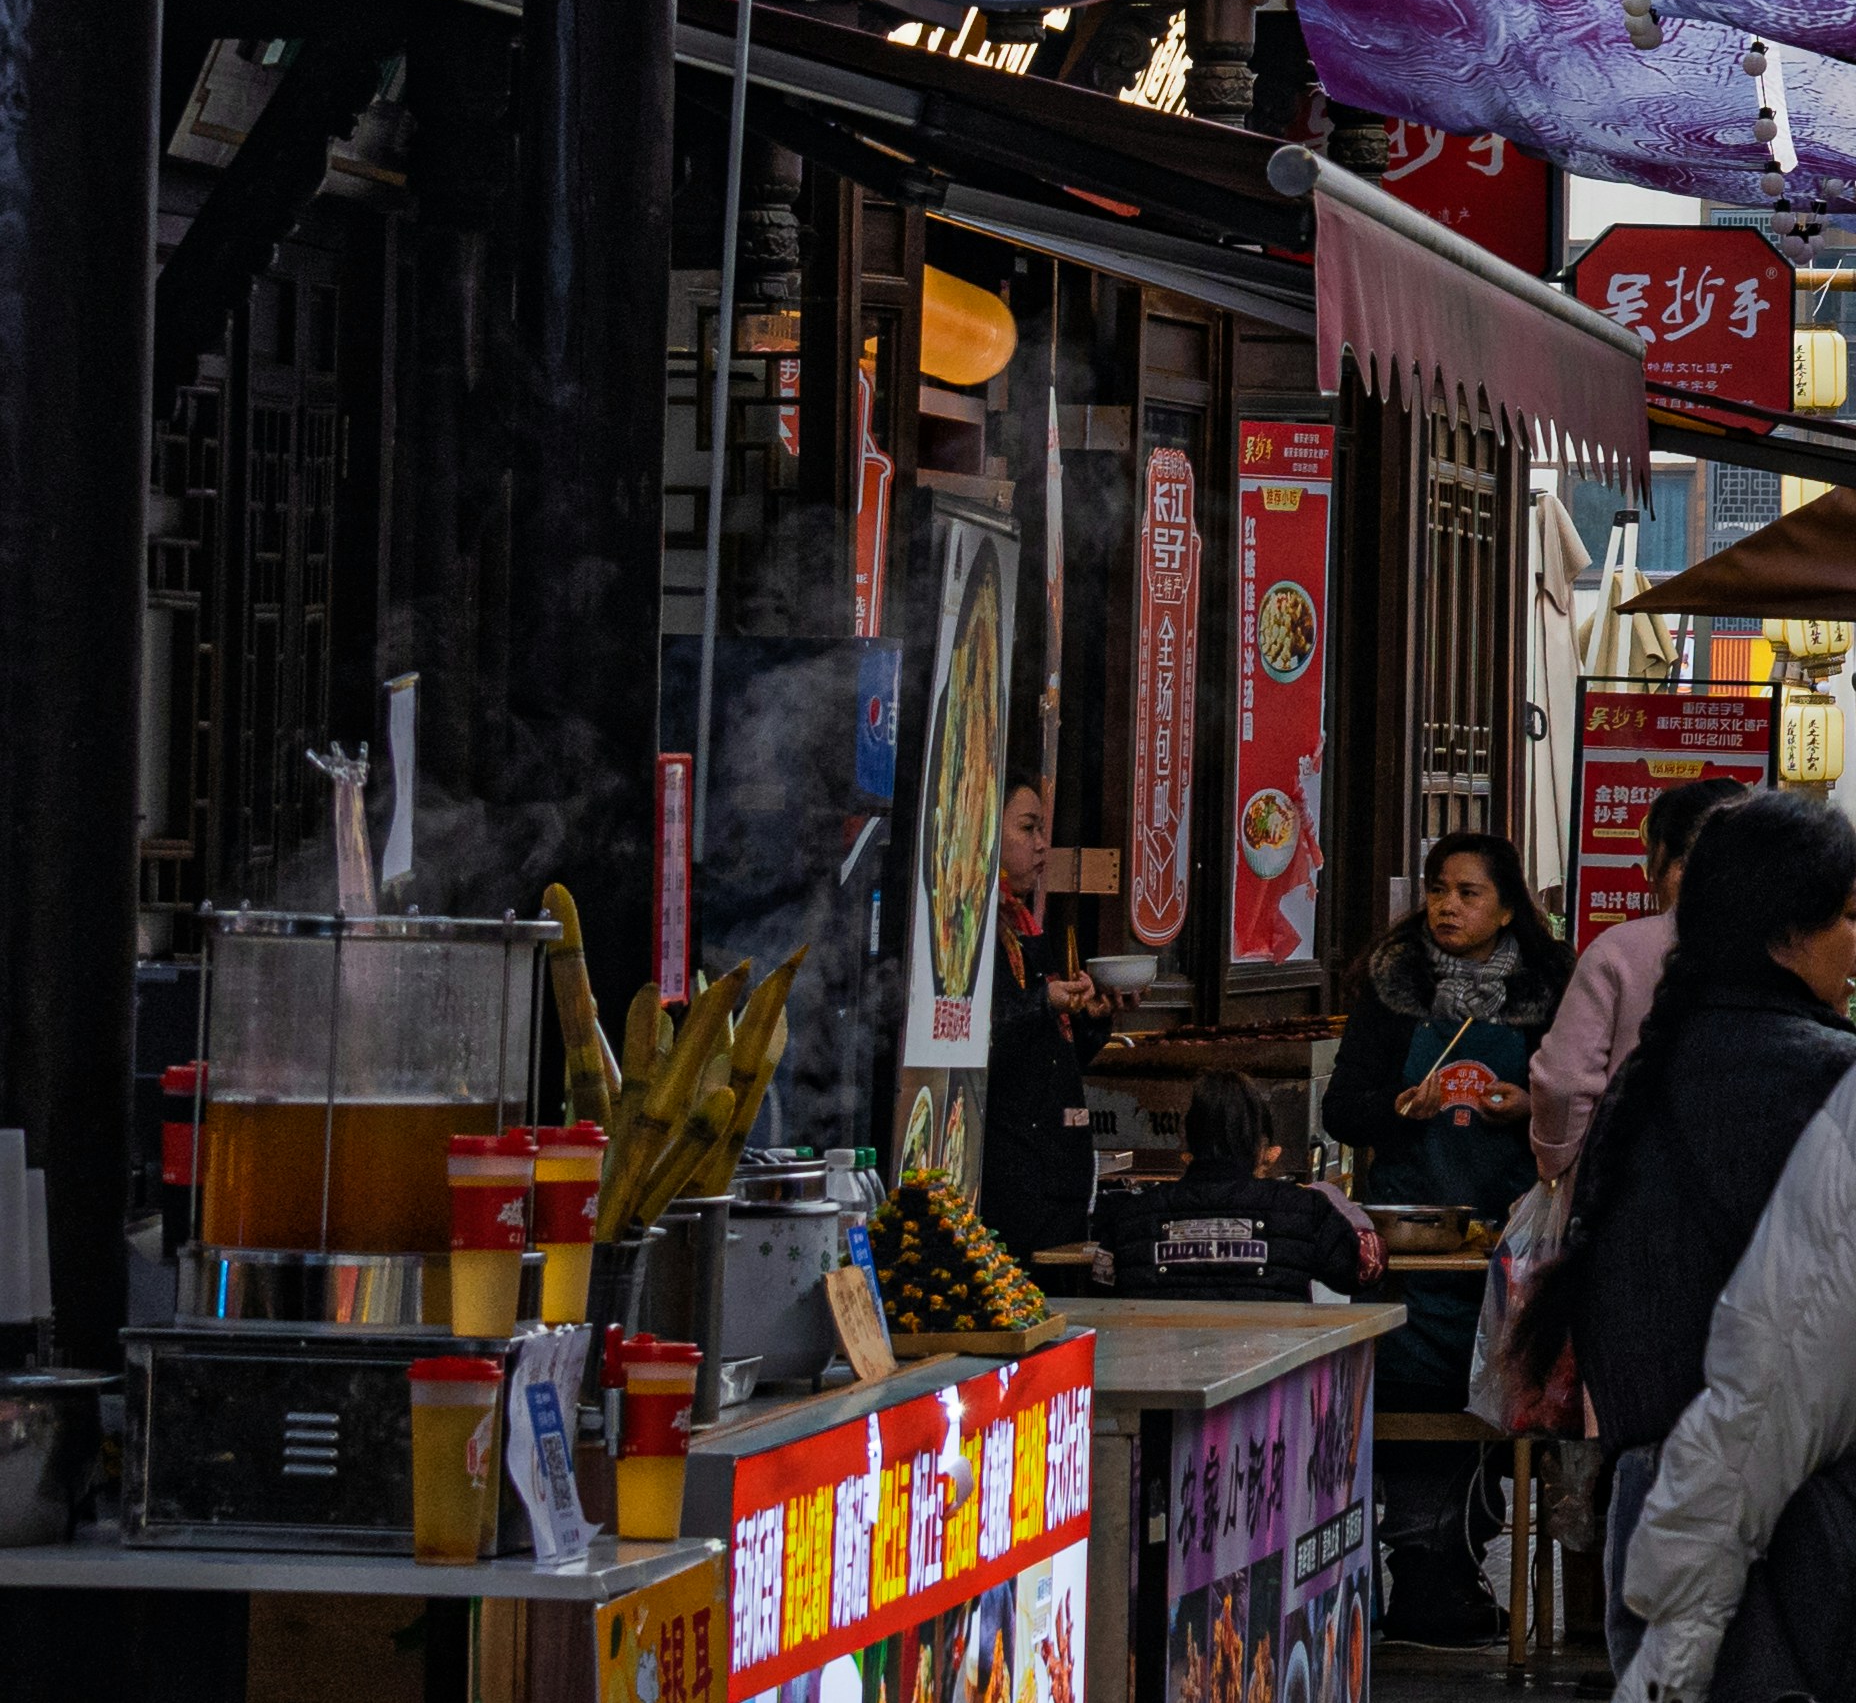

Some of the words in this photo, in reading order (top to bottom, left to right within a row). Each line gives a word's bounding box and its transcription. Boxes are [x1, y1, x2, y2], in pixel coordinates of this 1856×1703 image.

[1643, 361, 1733, 376] 物质文化遗产
[1266, 488, 1298, 505] 推荐小吃
[1682, 701, 1745, 716] 重庆老字号
[1153, 610, 1177, 830] 全场包邮
[1656, 715, 1769, 731] 重庆非物质文化遗产
[1680, 732, 1744, 747] 中华名小吃
[1593, 805, 1629, 824] 抄手
